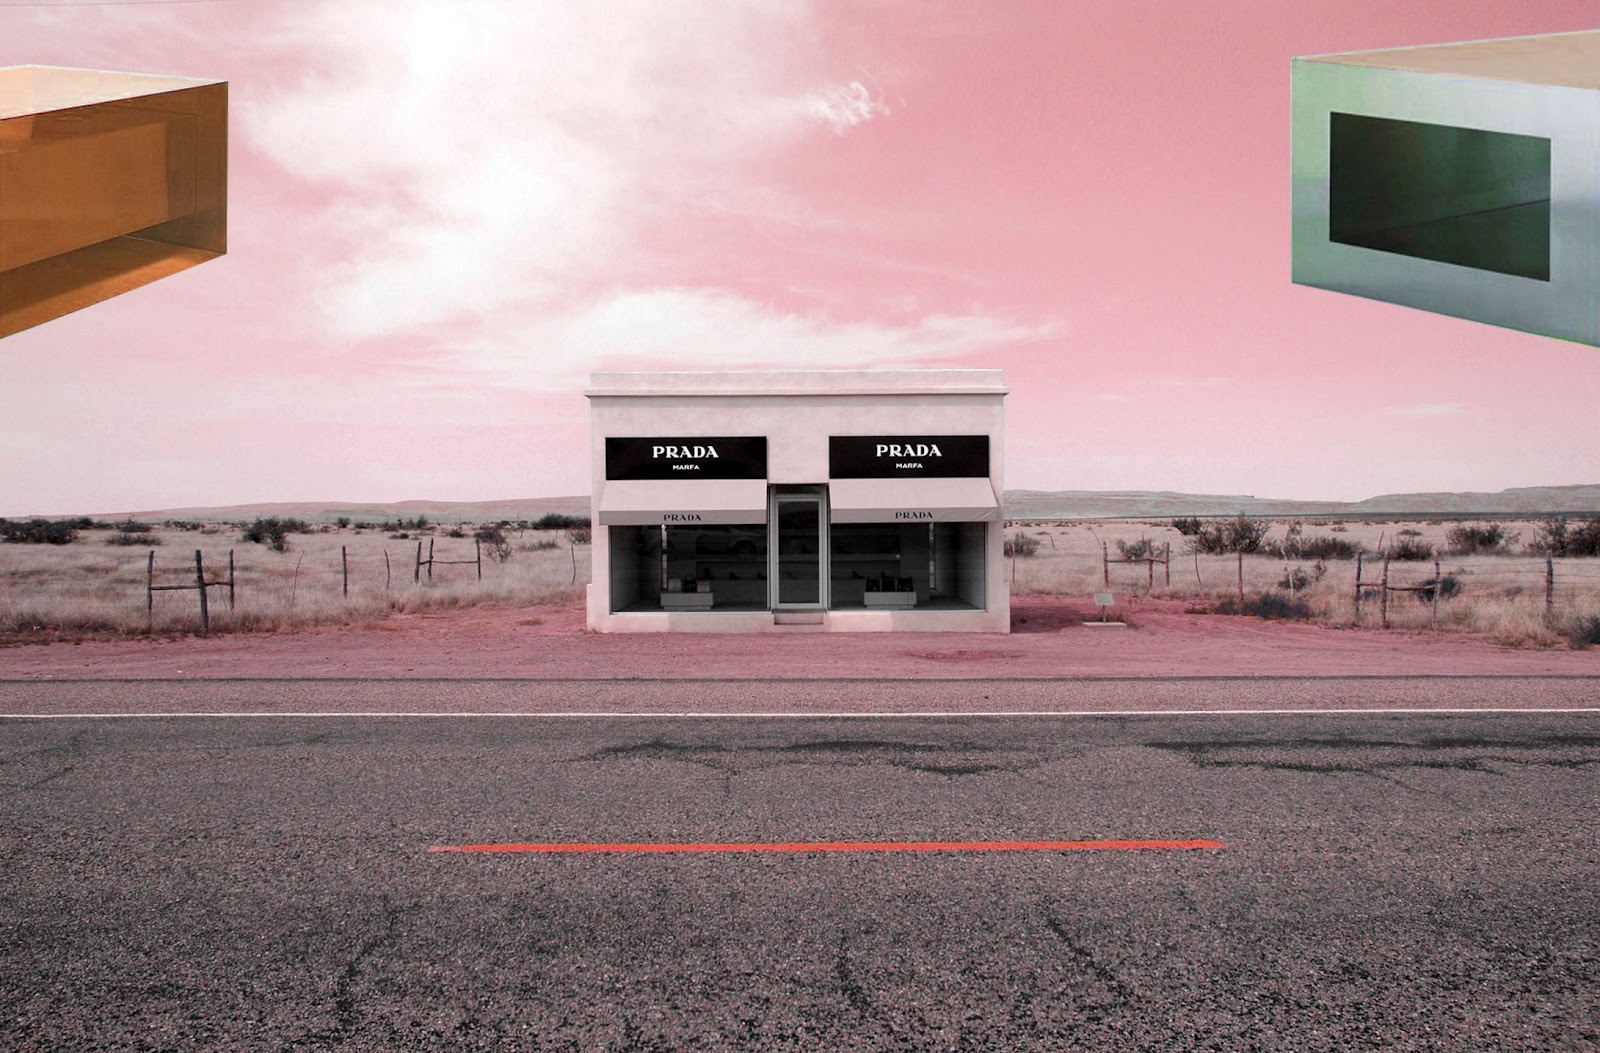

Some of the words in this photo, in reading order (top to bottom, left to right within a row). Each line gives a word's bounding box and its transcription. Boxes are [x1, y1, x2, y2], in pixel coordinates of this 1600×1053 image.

[652, 445, 719, 459] PRADA
[876, 444, 942, 457] PRADA
[663, 513, 702, 522] PRADA
[895, 511, 933, 520] PRADA
